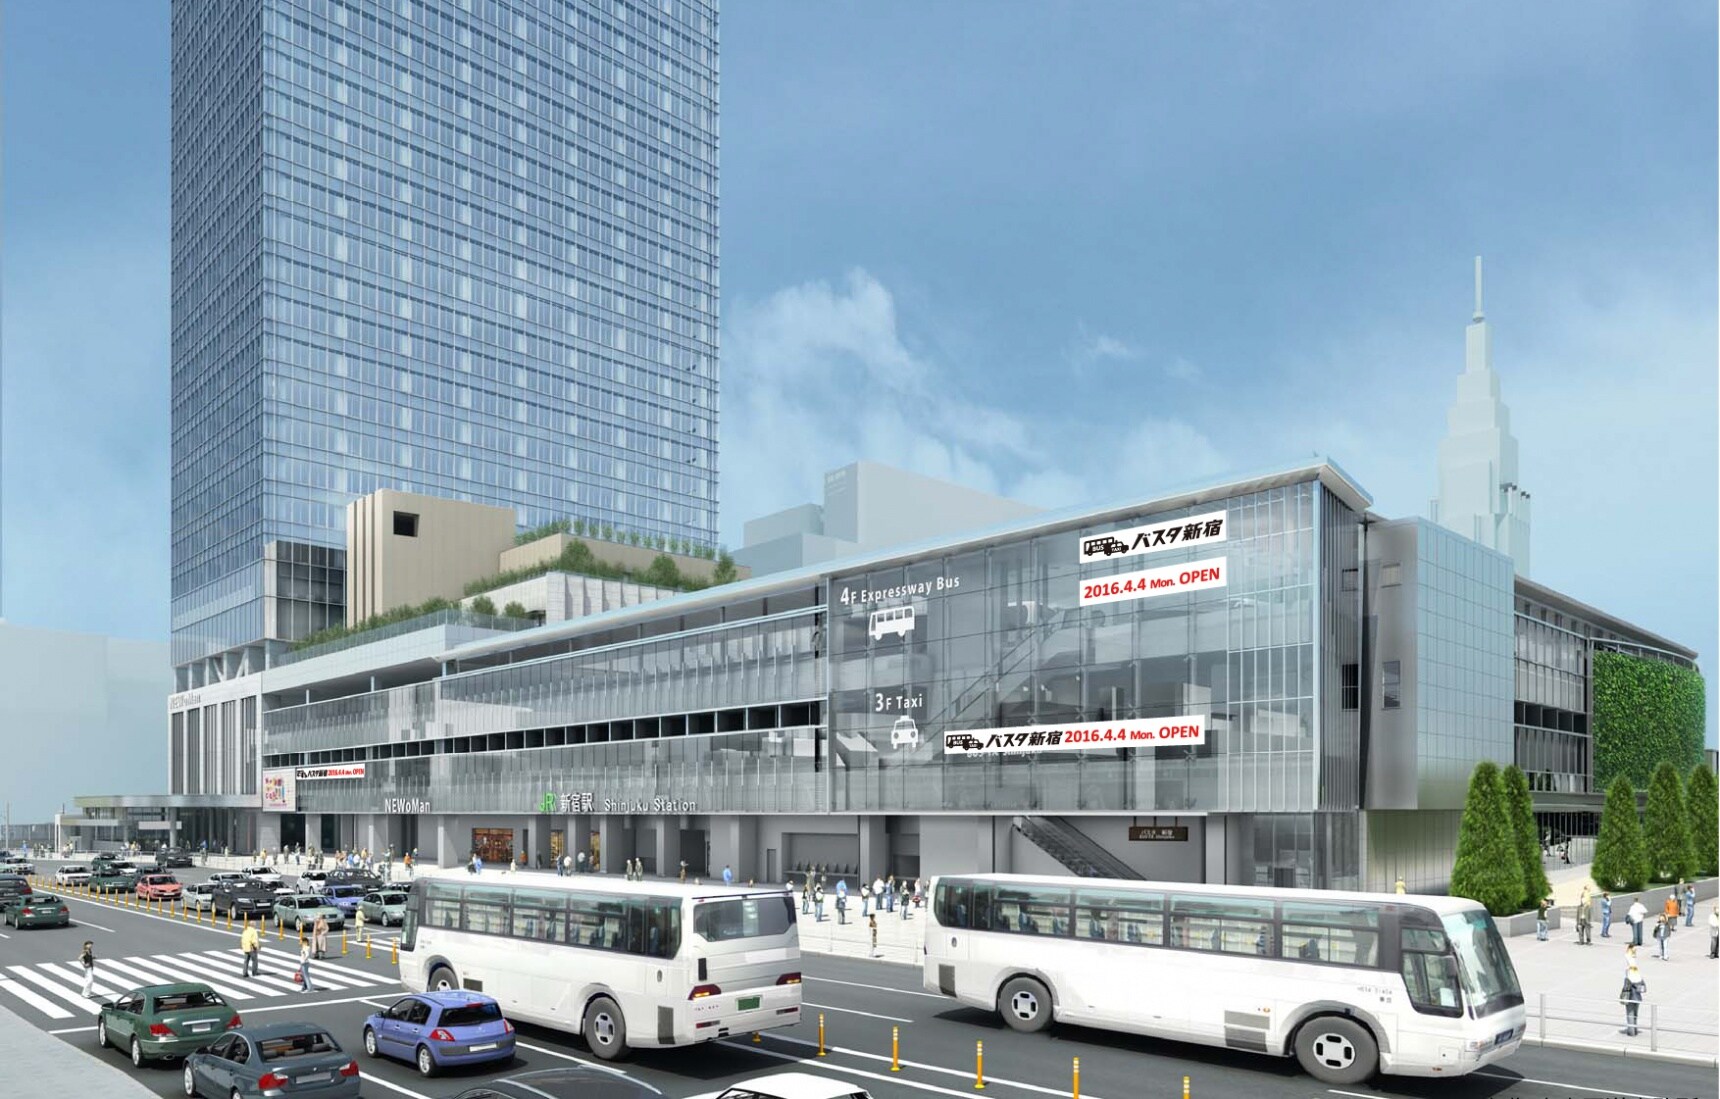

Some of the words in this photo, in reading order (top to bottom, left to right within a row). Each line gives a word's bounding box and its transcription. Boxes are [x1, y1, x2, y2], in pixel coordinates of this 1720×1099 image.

[1131, 519, 1224, 550] バスタ新宿
[1092, 544, 1105, 552] BUS
[840, 587, 857, 605] 4F
[861, 581, 933, 603] Expressway
[936, 577, 960, 590] Bus
[1084, 578, 1147, 599] 2016.4.4
[1150, 579, 1176, 589] Mon.
[1179, 567, 1220, 585] OPEN
[875, 693, 892, 712] 3F
[896, 693, 923, 709] Taxi
[985, 730, 1063, 748] バスタ新宿
[1064, 728, 1126, 743] 2016.4.4
[1130, 730, 1155, 740] Mon.
[1159, 725, 1200, 739] OPEN
[384, 798, 431, 814] NEWoMan
[538, 793, 557, 812] JR
[560, 792, 594, 812] 新宿駅
[604, 798, 649, 813] Shinjuku
[654, 798, 696, 812] Station
